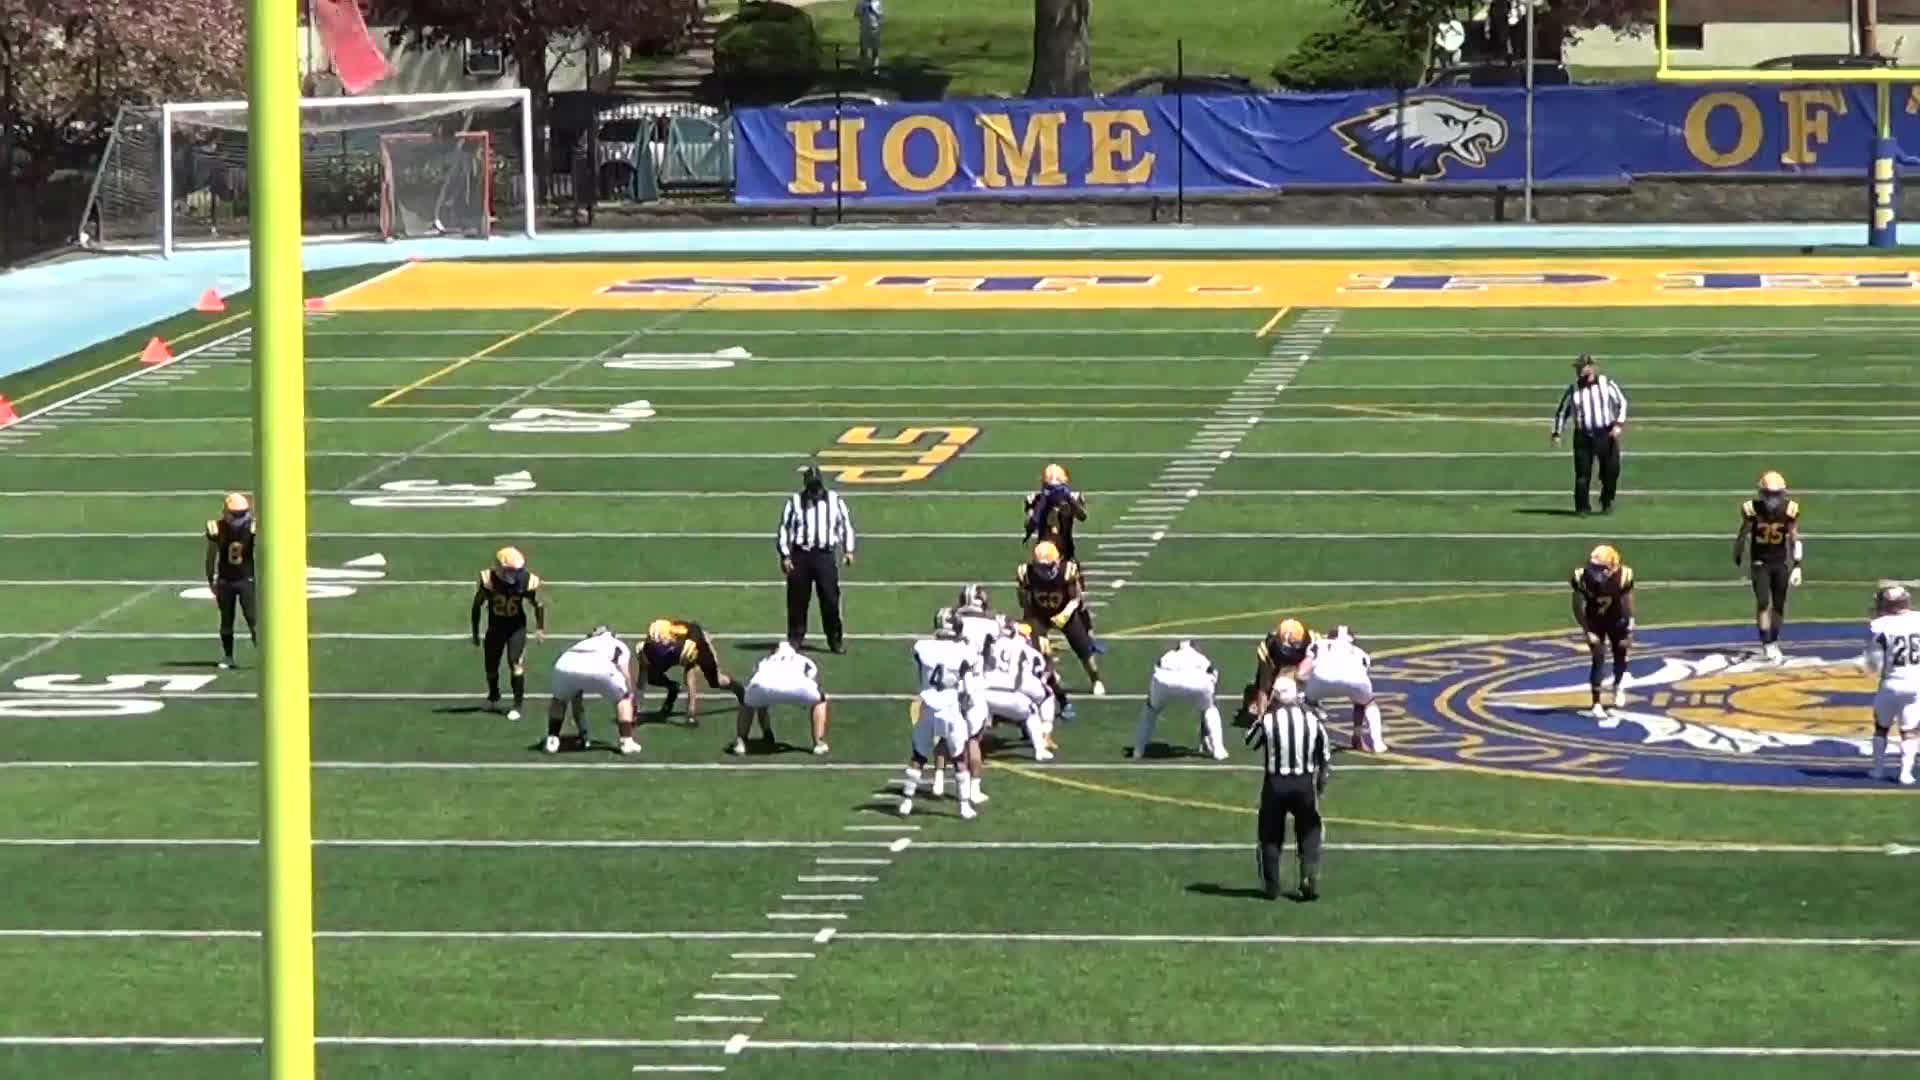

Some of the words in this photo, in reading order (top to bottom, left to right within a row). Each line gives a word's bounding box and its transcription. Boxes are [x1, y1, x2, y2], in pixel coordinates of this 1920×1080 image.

[786, 109, 1156, 194] HOME
[1684, 91, 1848, 168] OF
[1755, 522, 1785, 545] 35
[228, 541, 243, 565] 8
[0, 674, 218, 717] 50
